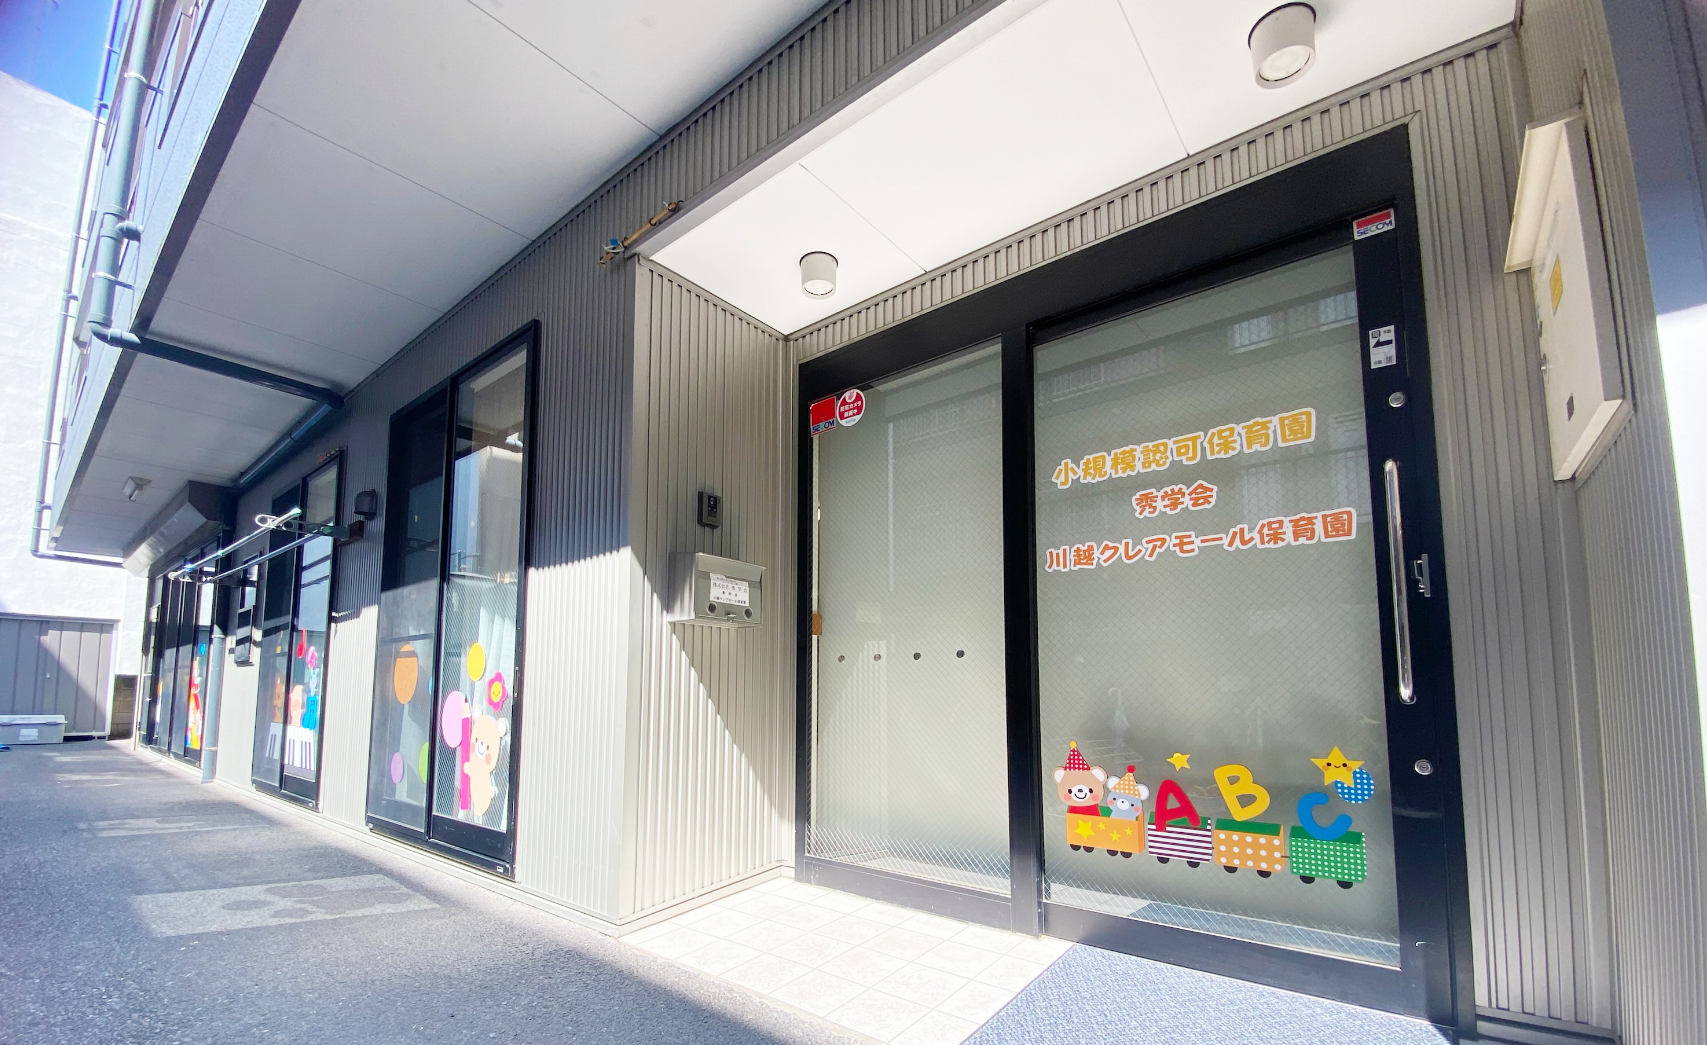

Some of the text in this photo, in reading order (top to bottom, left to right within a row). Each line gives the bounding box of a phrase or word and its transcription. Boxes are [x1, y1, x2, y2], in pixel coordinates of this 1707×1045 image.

[1356, 219, 1393, 237] SECOM
[812, 419, 835, 432] SECOM
[1053, 409, 1314, 487] 小規模認可保育園
[1133, 482, 1216, 516] 秀学会
[1046, 509, 1354, 571] 川越クレアモール保育園
[1154, 764, 1353, 840] A B C
